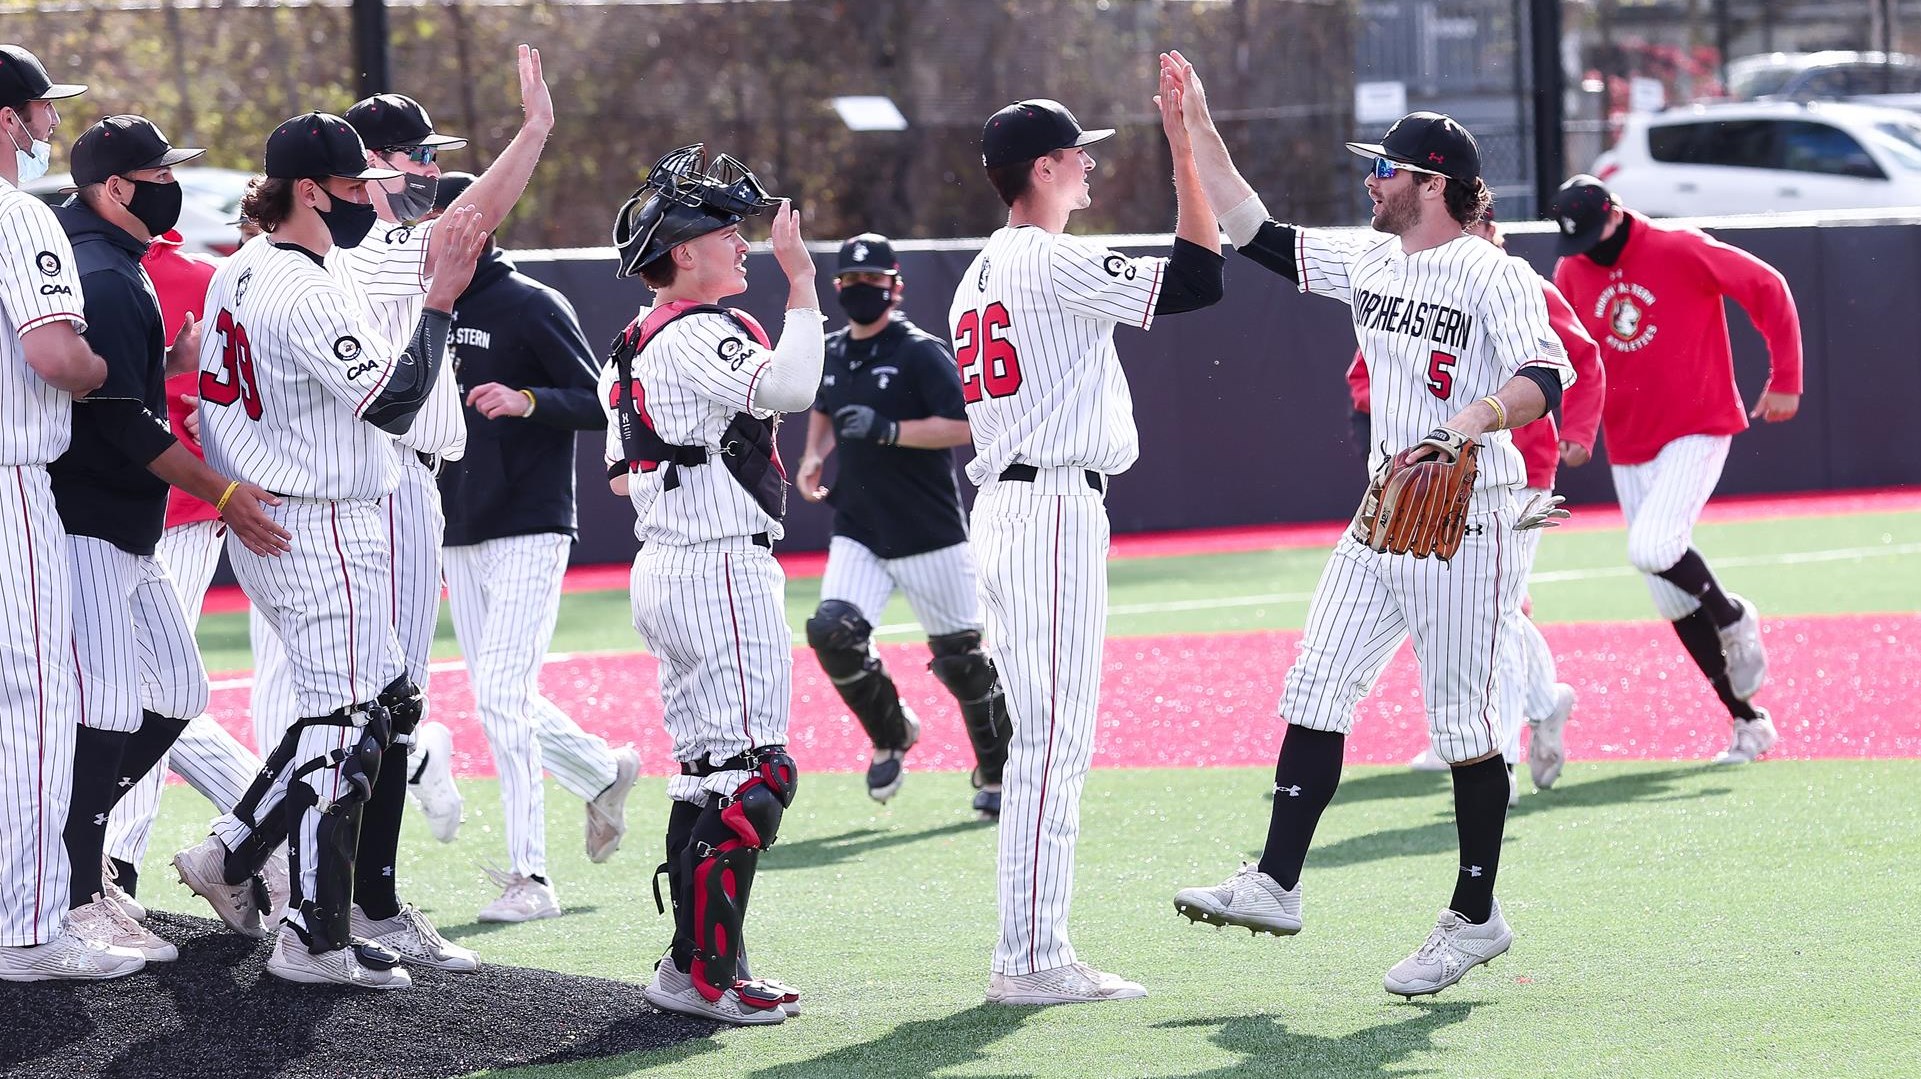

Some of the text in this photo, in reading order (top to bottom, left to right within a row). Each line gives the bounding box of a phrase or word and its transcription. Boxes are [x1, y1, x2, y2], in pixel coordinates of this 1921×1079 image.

[40, 284, 72, 296] CAA
[199, 307, 264, 422] 39
[346, 359, 379, 381] CAA
[731, 348, 757, 372] CAA
[955, 300, 1023, 405] 26
[1427, 349, 1457, 402] 5
